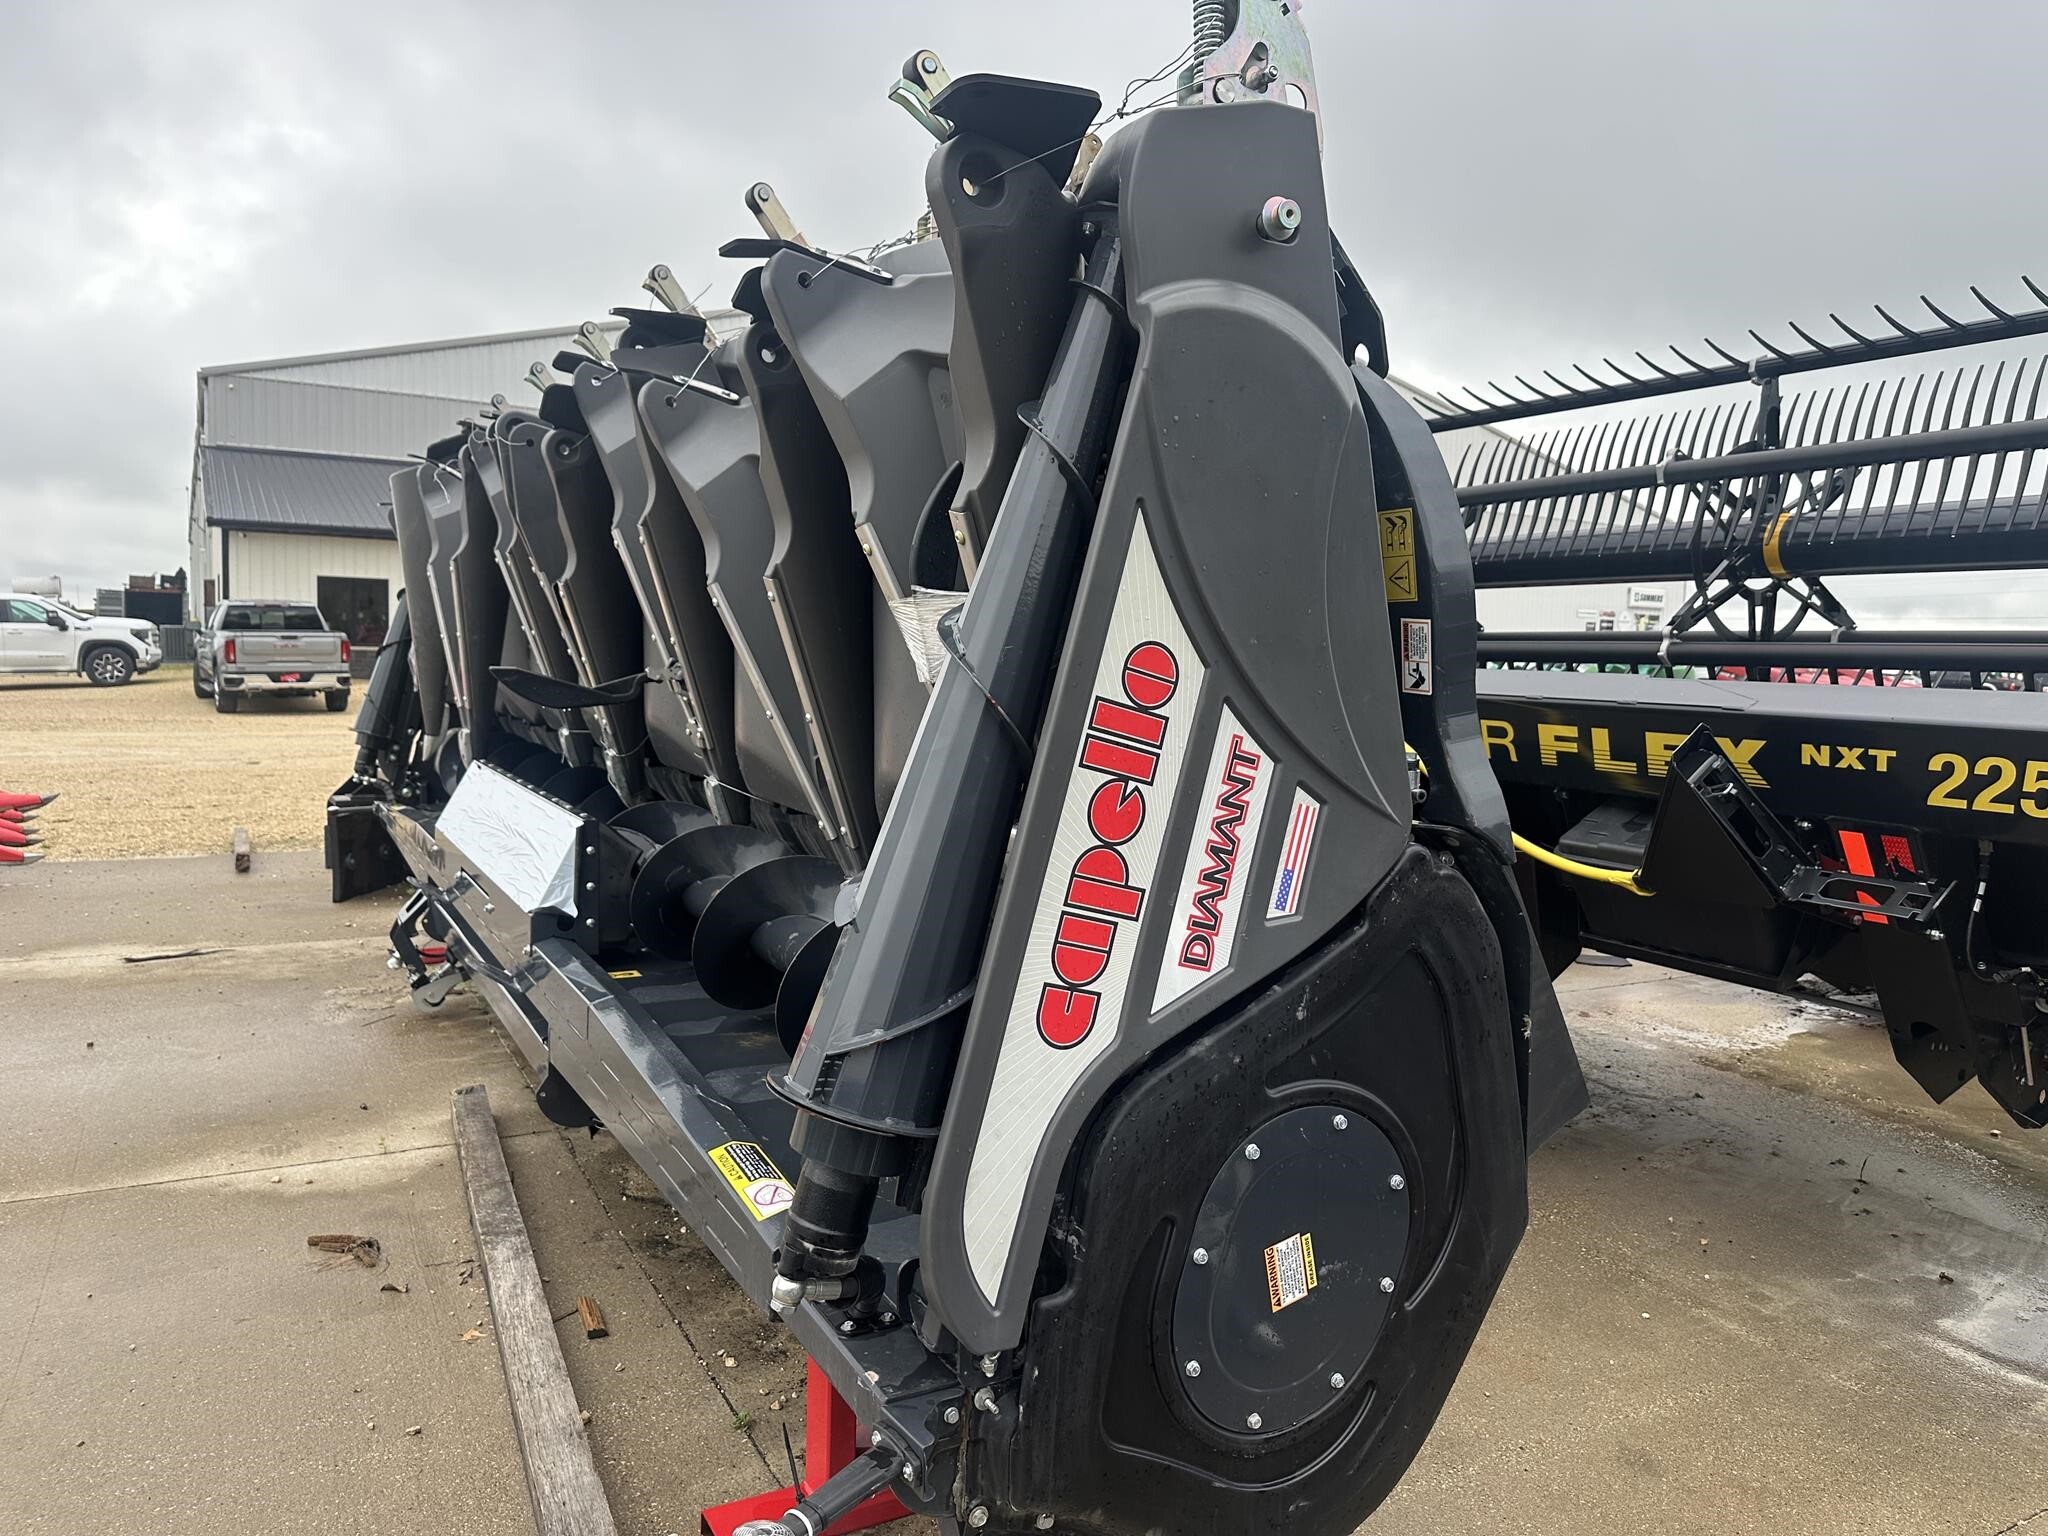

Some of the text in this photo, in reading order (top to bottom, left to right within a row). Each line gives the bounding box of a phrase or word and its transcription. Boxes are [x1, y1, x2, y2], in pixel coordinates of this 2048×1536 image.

[1537, 724, 1771, 788] FLEX
[1801, 744, 1896, 771] NXT
[1036, 640, 1179, 1050] capello
[1178, 733, 1263, 972] DIAMANT
[717, 1153, 740, 1177] CAUTION
[1266, 1247, 1280, 1298] WARNING
[1307, 1260, 1315, 1285] GREASE
